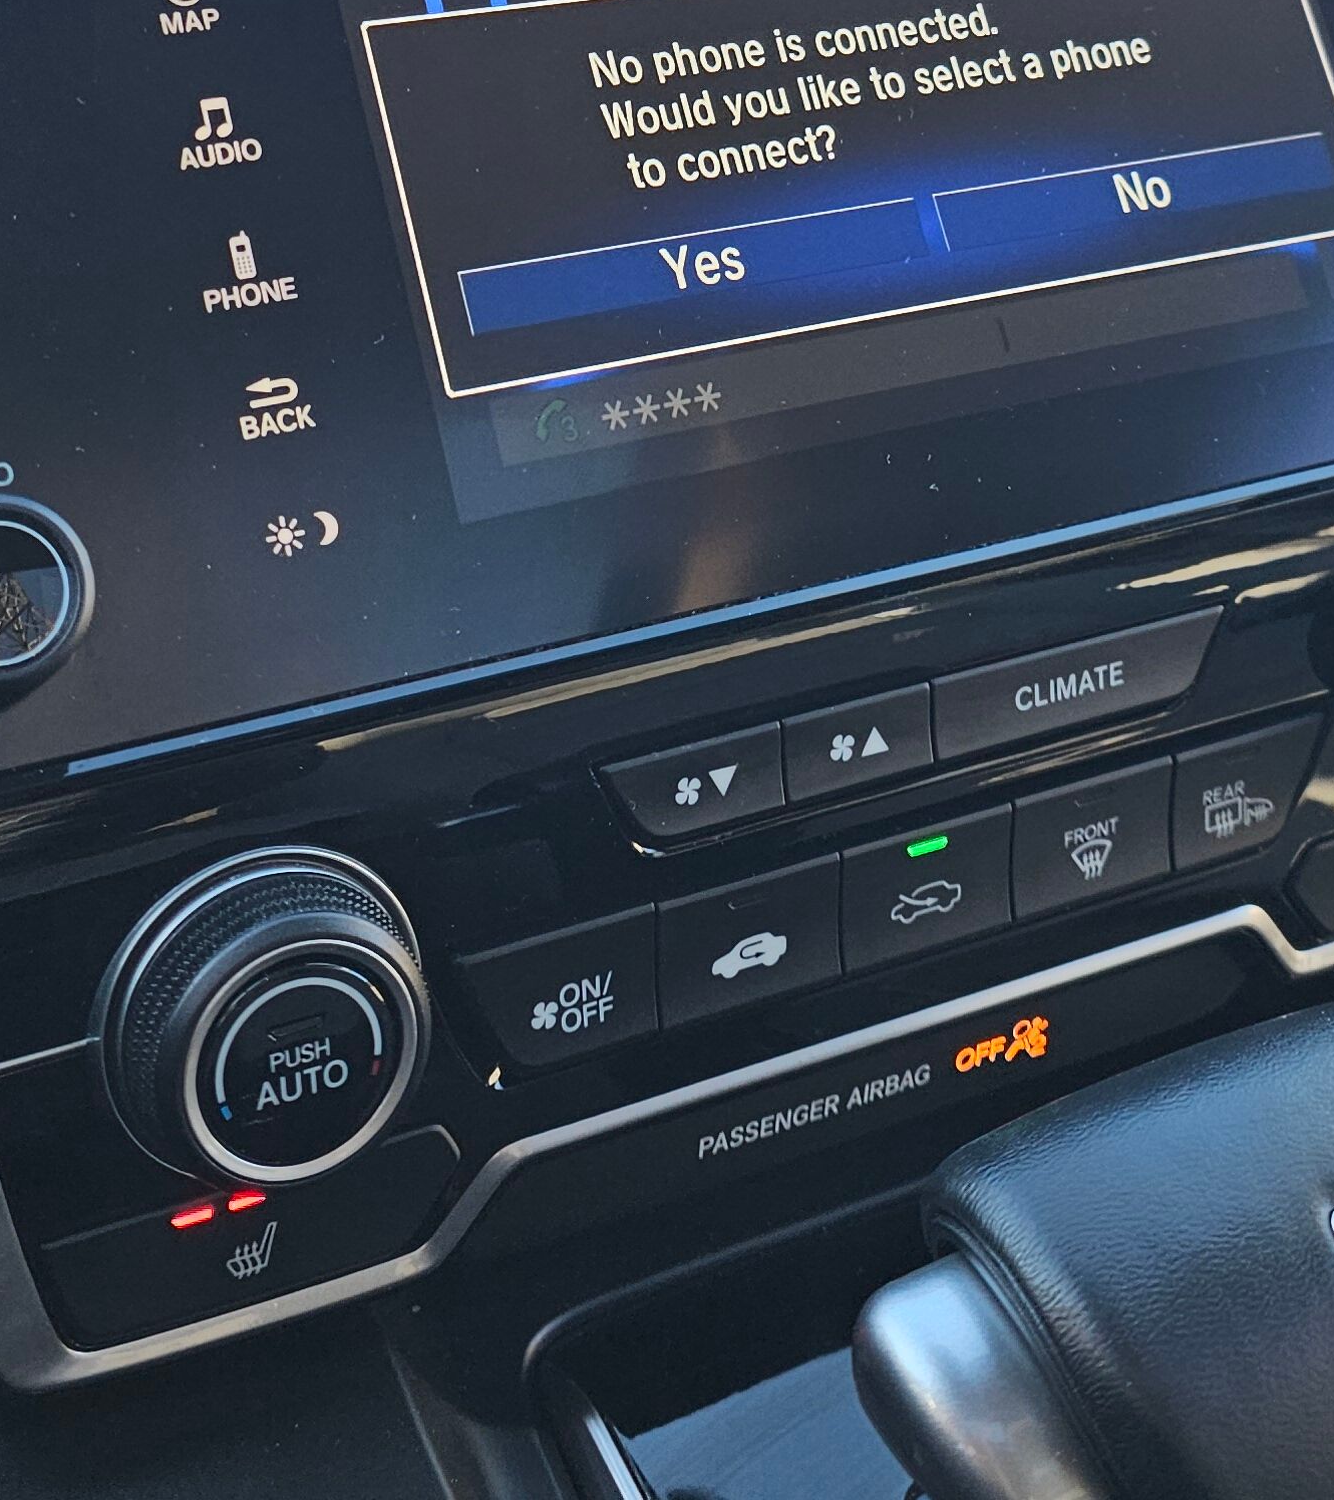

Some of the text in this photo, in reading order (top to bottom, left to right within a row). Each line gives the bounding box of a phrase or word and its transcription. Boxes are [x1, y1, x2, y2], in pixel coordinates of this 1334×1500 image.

[159, 8, 221, 36] MAP
[588, 2, 1000, 88] No phone is connected.
[600, 34, 1152, 140] Would you like to select a phone
[180, 138, 263, 171] AUDIO
[626, 125, 837, 189] to connect?
[1111, 170, 1172, 214] No
[658, 244, 746, 290] Yes
[203, 276, 299, 314] PHONE
[239, 404, 317, 441] BACK
[1014, 660, 1125, 711] CLIMATE
[1202, 779, 1246, 806] REAR
[1064, 816, 1120, 849] FRONT
[559, 970, 614, 1007] ON/
[559, 994, 615, 1034] OFF
[268, 1036, 332, 1076] PUSH
[256, 1058, 349, 1111] AUTO
[697, 1035, 1005, 1160] PASSENGER AIRBAG OFF
